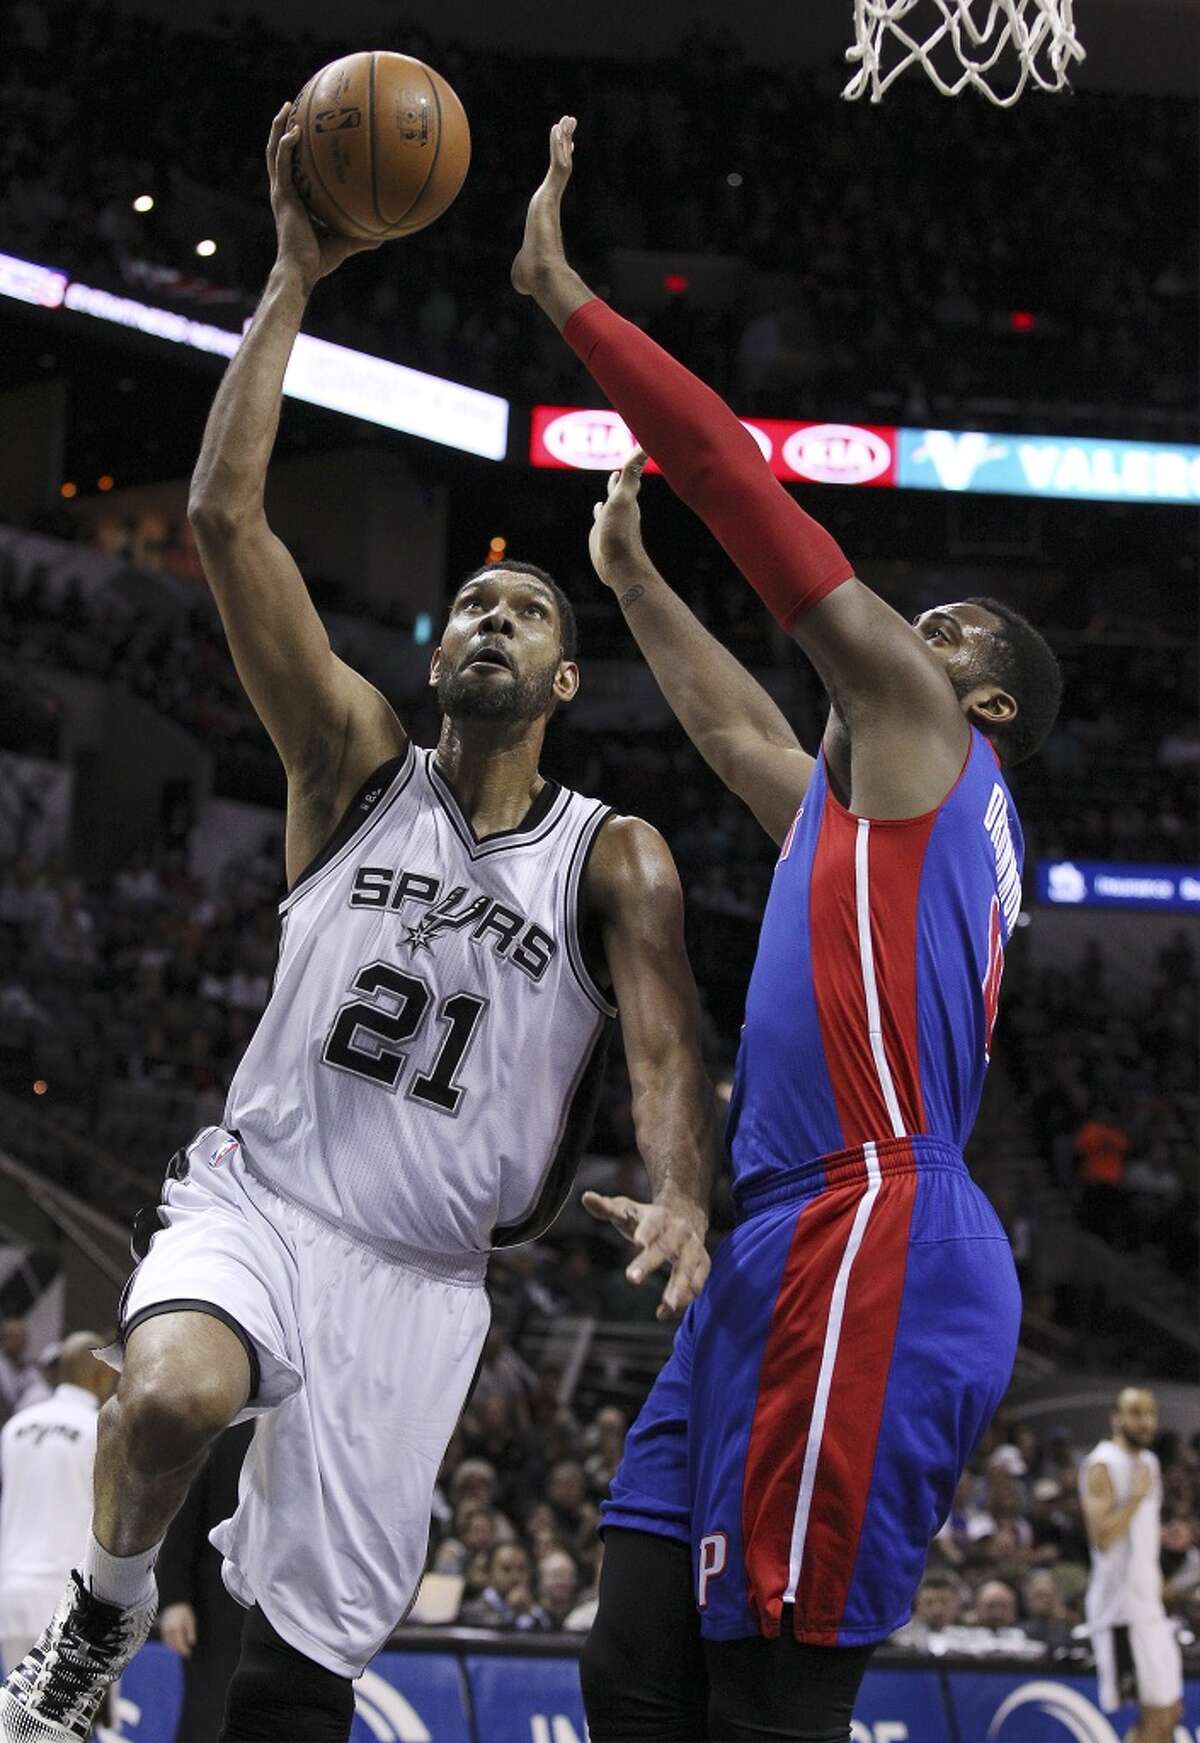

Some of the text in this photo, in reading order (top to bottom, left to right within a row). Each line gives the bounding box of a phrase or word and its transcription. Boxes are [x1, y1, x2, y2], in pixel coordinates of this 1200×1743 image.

[798, 430, 872, 462] KIA
[1016, 443, 1200, 500] VALER
[350, 866, 557, 984] SPURS
[321, 960, 490, 1118] 21
